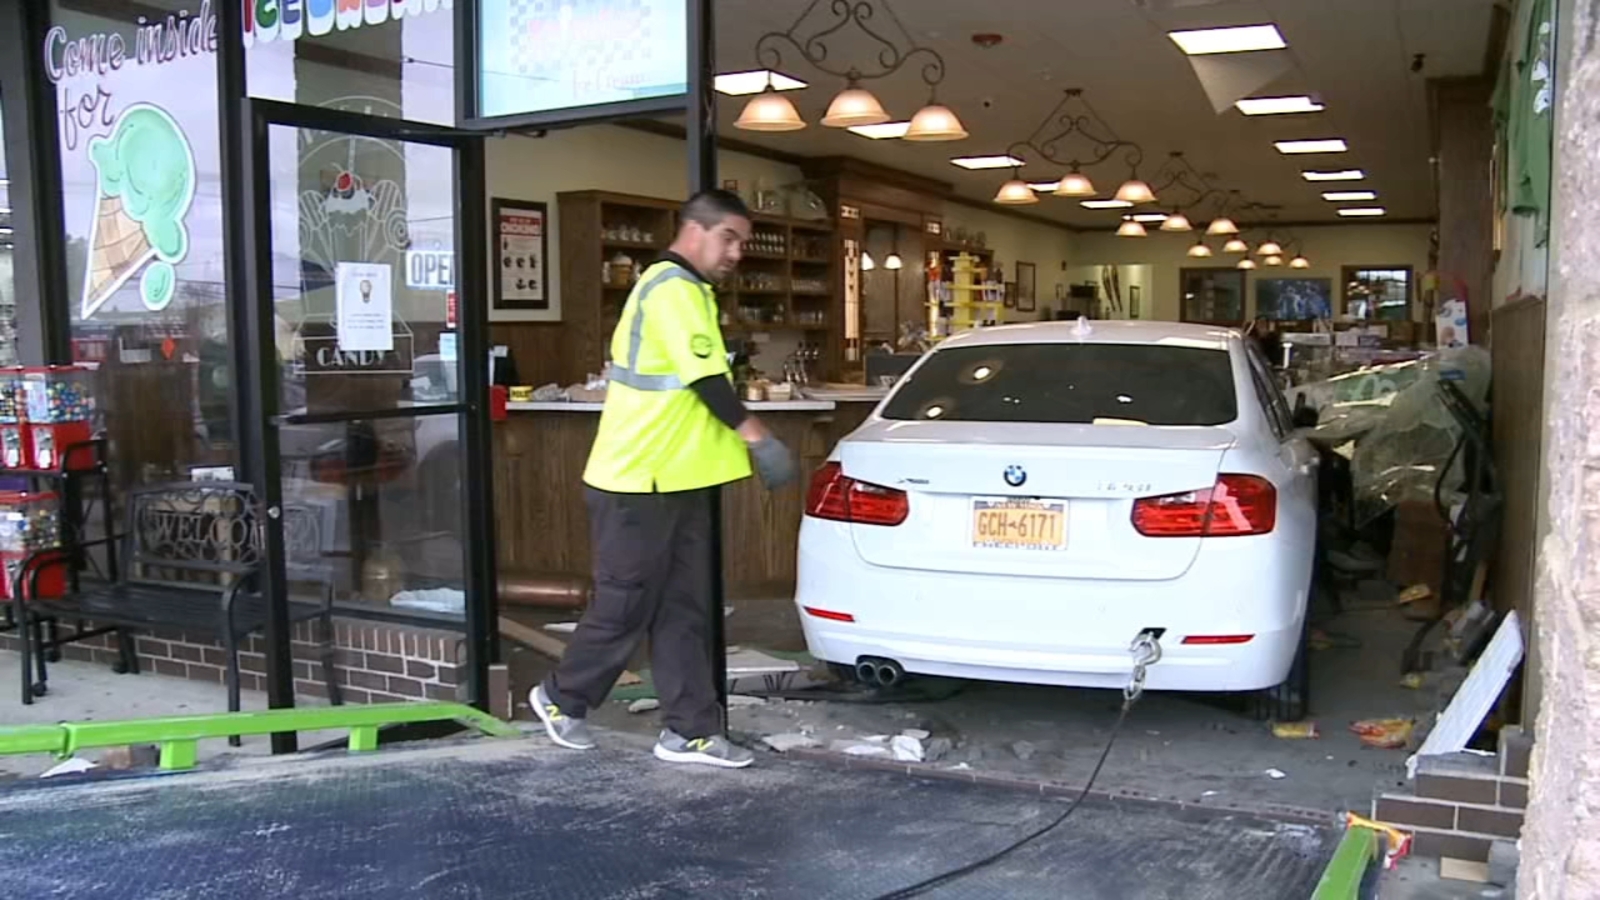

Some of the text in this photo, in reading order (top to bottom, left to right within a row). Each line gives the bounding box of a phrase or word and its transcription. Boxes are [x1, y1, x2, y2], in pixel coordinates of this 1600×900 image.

[44, 26, 125, 84] Come
[60, 84, 115, 151] for
[411, 252, 454, 286] OPE
